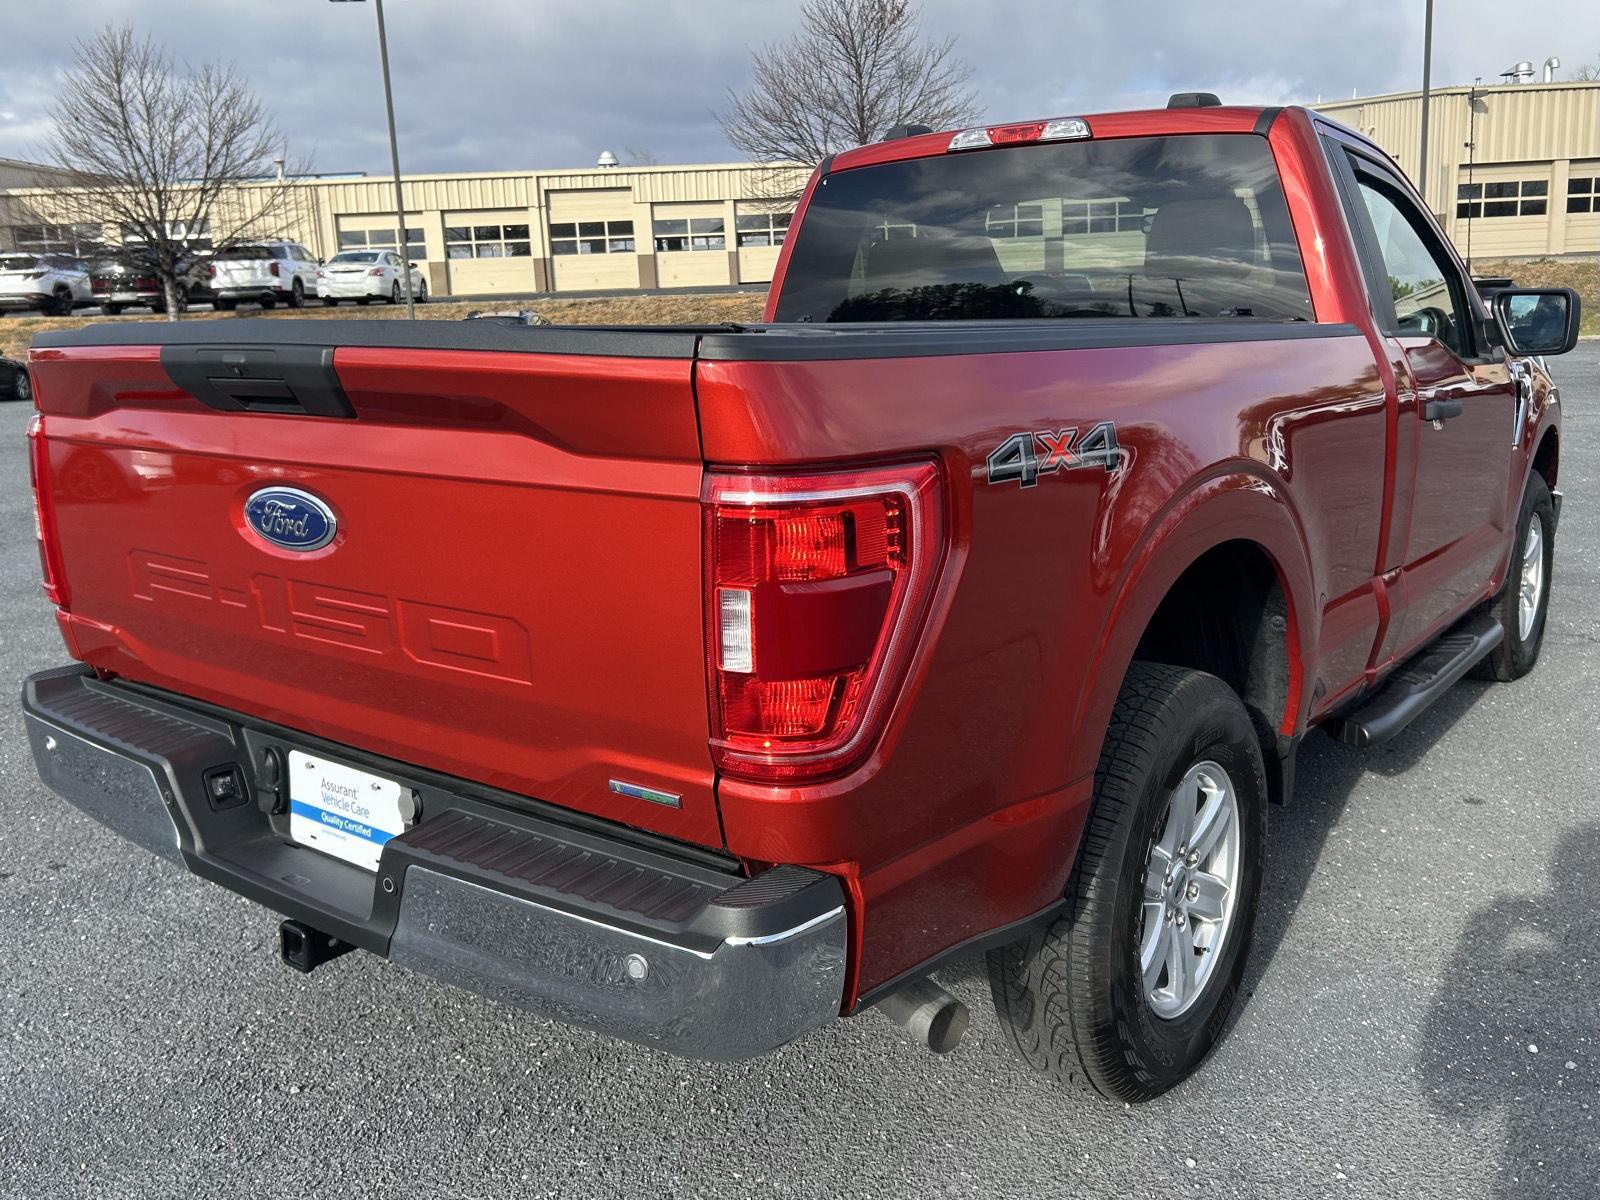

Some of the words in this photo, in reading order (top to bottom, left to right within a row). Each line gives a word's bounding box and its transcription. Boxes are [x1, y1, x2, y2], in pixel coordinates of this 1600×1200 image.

[261, 499, 309, 538] Ford
[127, 548, 532, 686] F-150
[321, 777, 358, 800] Assurant
[321, 790, 350, 812] Vehicle
[350, 801, 370, 818] Care
[321, 812, 344, 829] Quality
[344, 820, 372, 837] Certified
